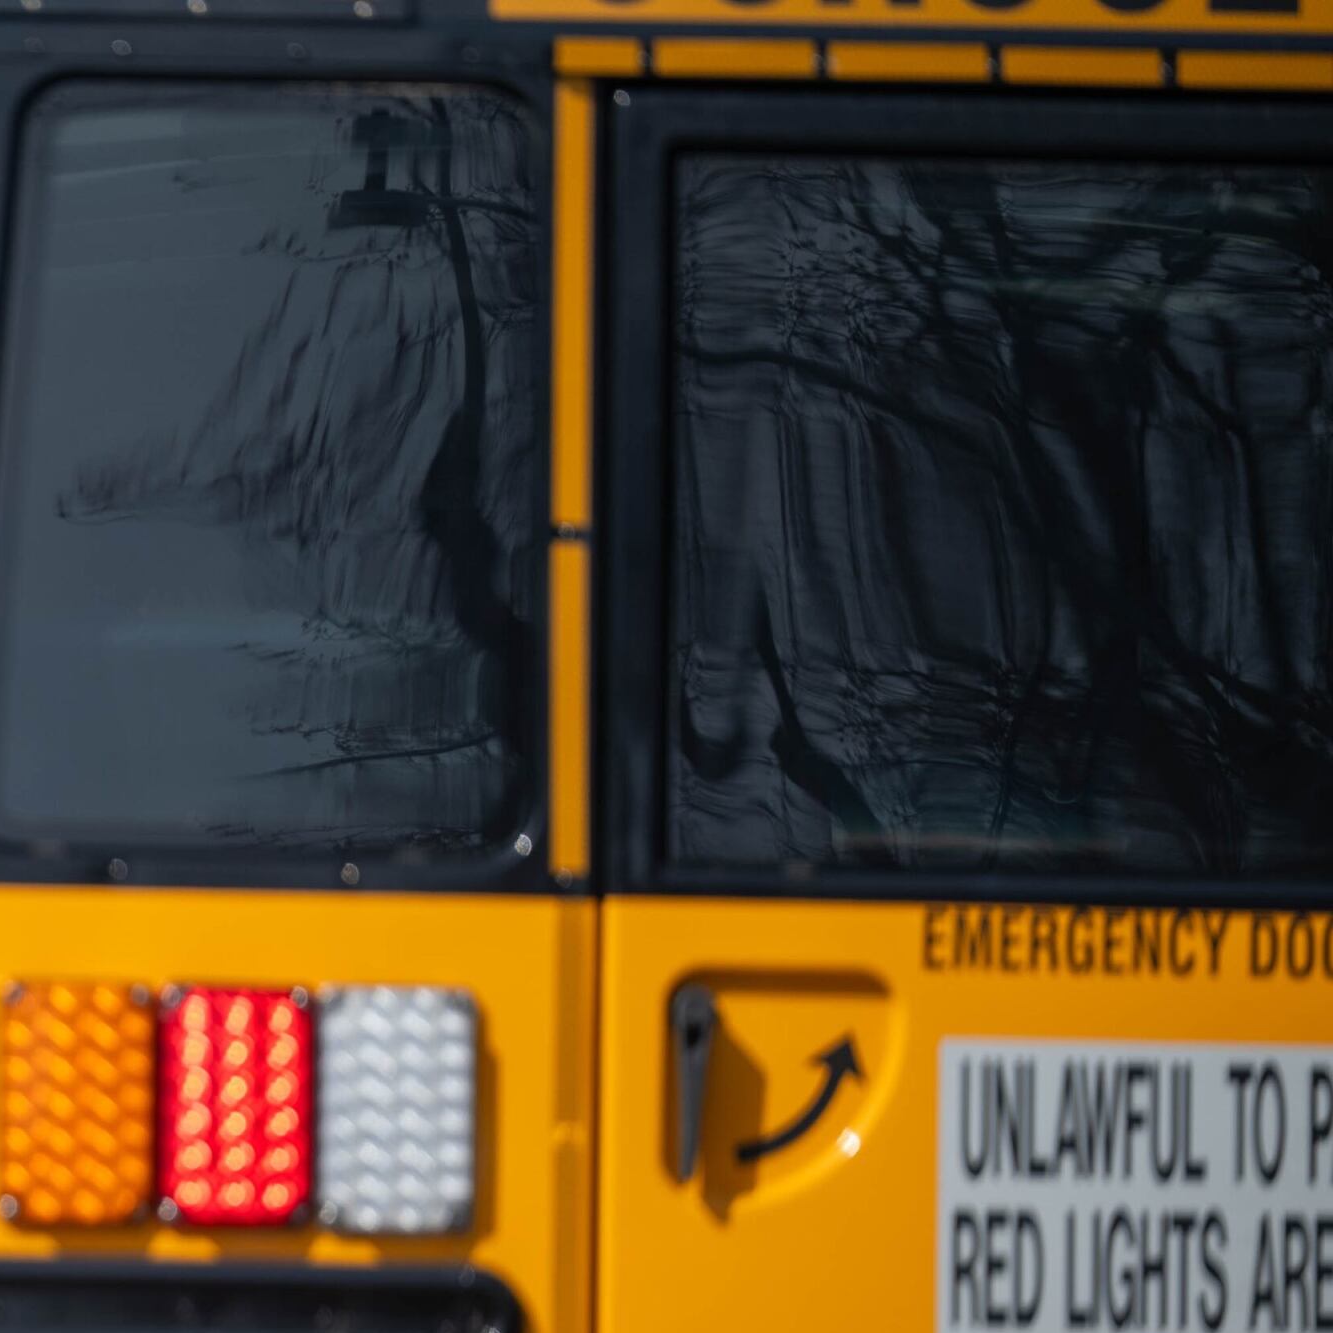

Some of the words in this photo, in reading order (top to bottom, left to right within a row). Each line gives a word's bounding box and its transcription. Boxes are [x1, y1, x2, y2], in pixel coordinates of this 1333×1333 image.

[921, 903, 1228, 978] EMERGENCY
[958, 1056, 1206, 1184] UNLAWFUL
[1230, 1059, 1288, 1186] TO
[1307, 1062, 1333, 1188] P
[950, 1206, 1045, 1327] RED
[1065, 1207, 1229, 1333] LIGHTS
